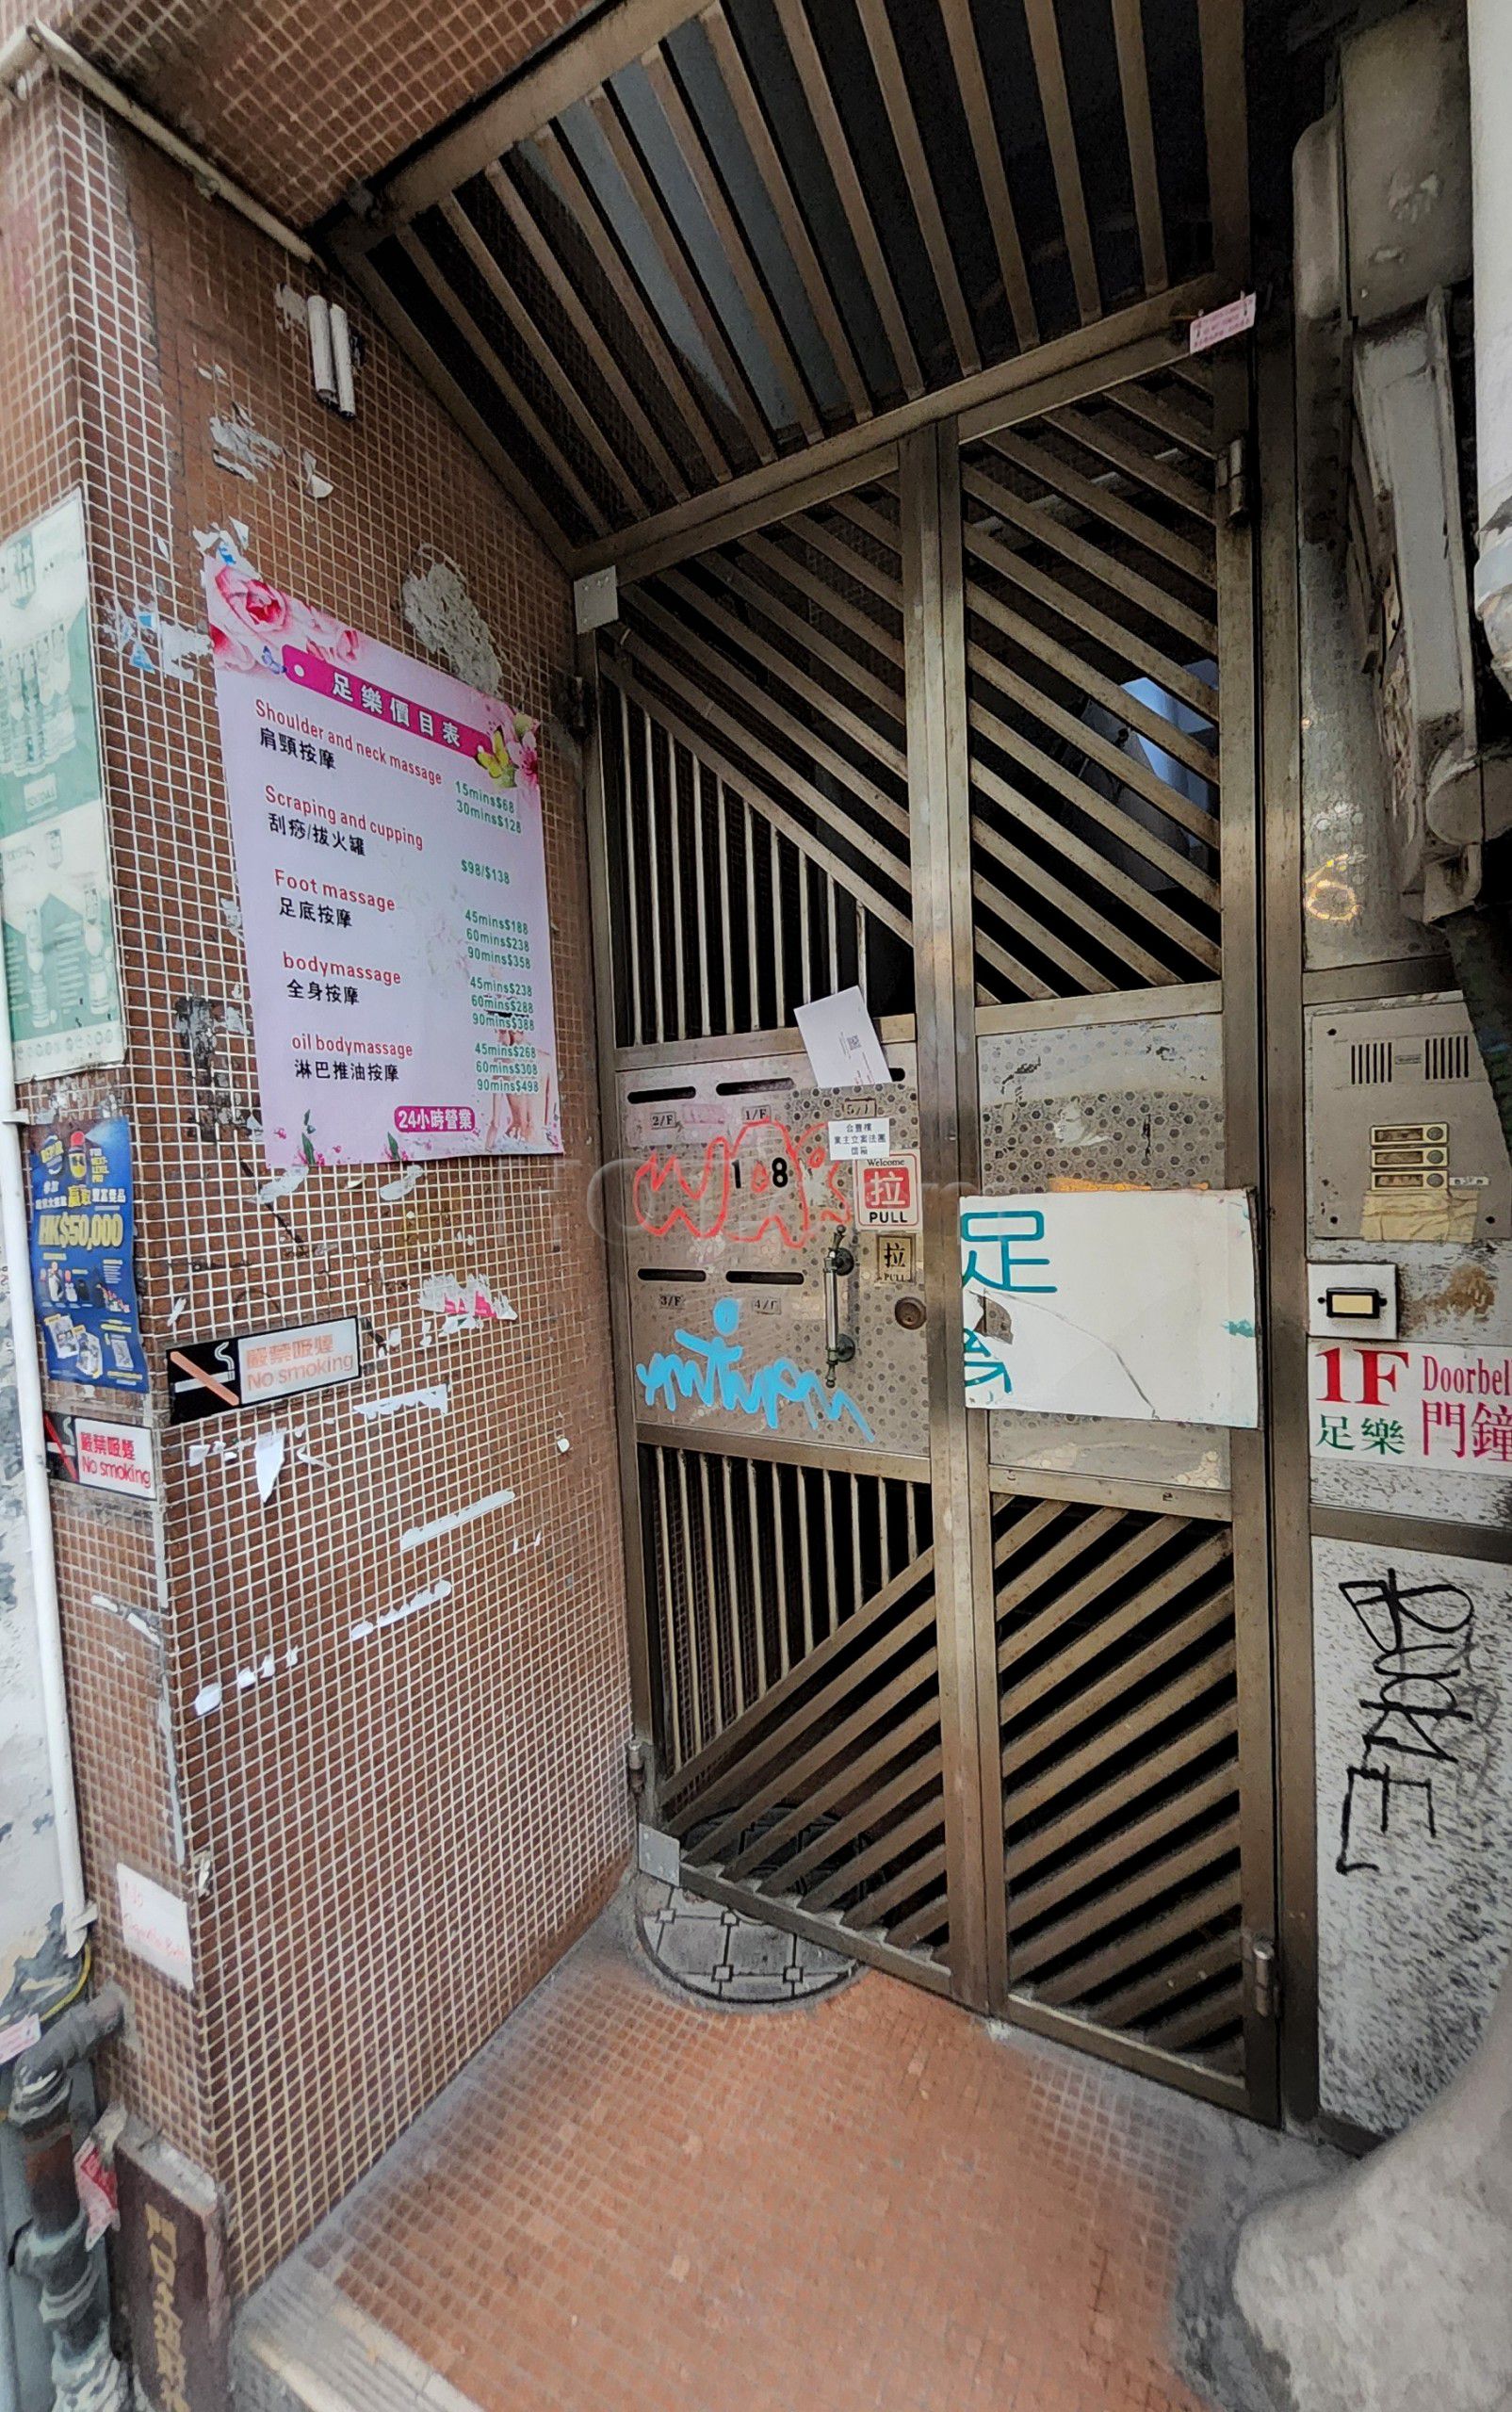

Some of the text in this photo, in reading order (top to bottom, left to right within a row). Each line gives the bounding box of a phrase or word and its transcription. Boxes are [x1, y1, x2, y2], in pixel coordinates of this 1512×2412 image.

[332, 672, 462, 747] 足樂價目表
[255, 698, 442, 786] Shoulder and neck massage
[259, 726, 336, 771] 肩頸按摩
[455, 780, 514, 814] 15mins$68
[266, 785, 423, 851] Scraping and cupping
[274, 869, 396, 912] Foot massage
[279, 897, 353, 928] 足底按摩
[283, 951, 402, 986] bodymassage
[285, 979, 360, 1005] 全身按摩
[291, 1034, 413, 1059] oil bodymassage
[294, 1059, 400, 1083] 淋巴推油按摩
[652, 1115, 674, 1126] 2/F
[867, 1157, 905, 1167] Welcome
[870, 1170, 906, 1206] 拉
[39, 1212, 123, 1250] HK$50,000
[869, 1211, 908, 1223] PULL
[883, 1242, 905, 1268] 拉
[884, 1273, 906, 1282] PULL
[247, 1354, 353, 1391] No smoking
[1315, 1347, 1409, 1406] 1F
[1315, 1413, 1406, 1455] 足樂
[81, 1456, 151, 1490] No smoking
